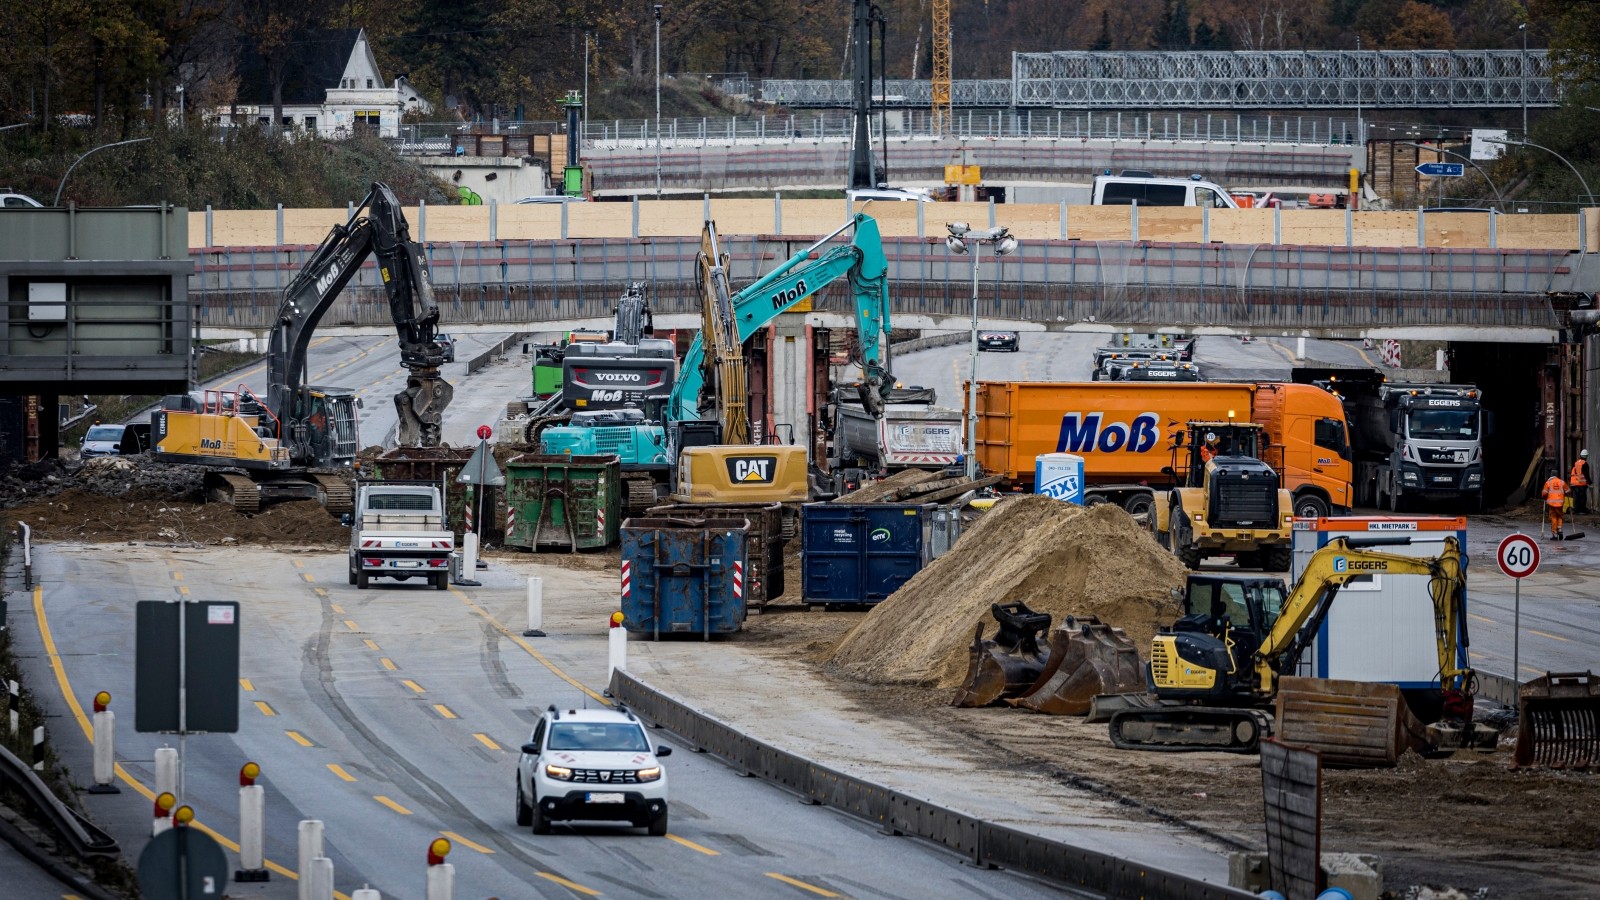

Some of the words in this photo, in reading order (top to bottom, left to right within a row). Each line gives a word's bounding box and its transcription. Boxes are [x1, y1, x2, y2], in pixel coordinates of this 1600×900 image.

[316, 261, 339, 296] Moß
[771, 279, 808, 310] Moß
[595, 373, 641, 382] VOLVO
[591, 389, 623, 402] Moß
[1428, 399, 1461, 407] EGGERS
[753, 419, 762, 446] KEHL
[1056, 412, 1160, 453] Moß
[201, 437, 222, 450] Moß
[1458, 452, 1465, 461] A
[736, 460, 769, 481] CAT
[872, 532, 887, 541] emr
[1507, 546, 1531, 566] 60
[1348, 560, 1388, 570] EGGERS
